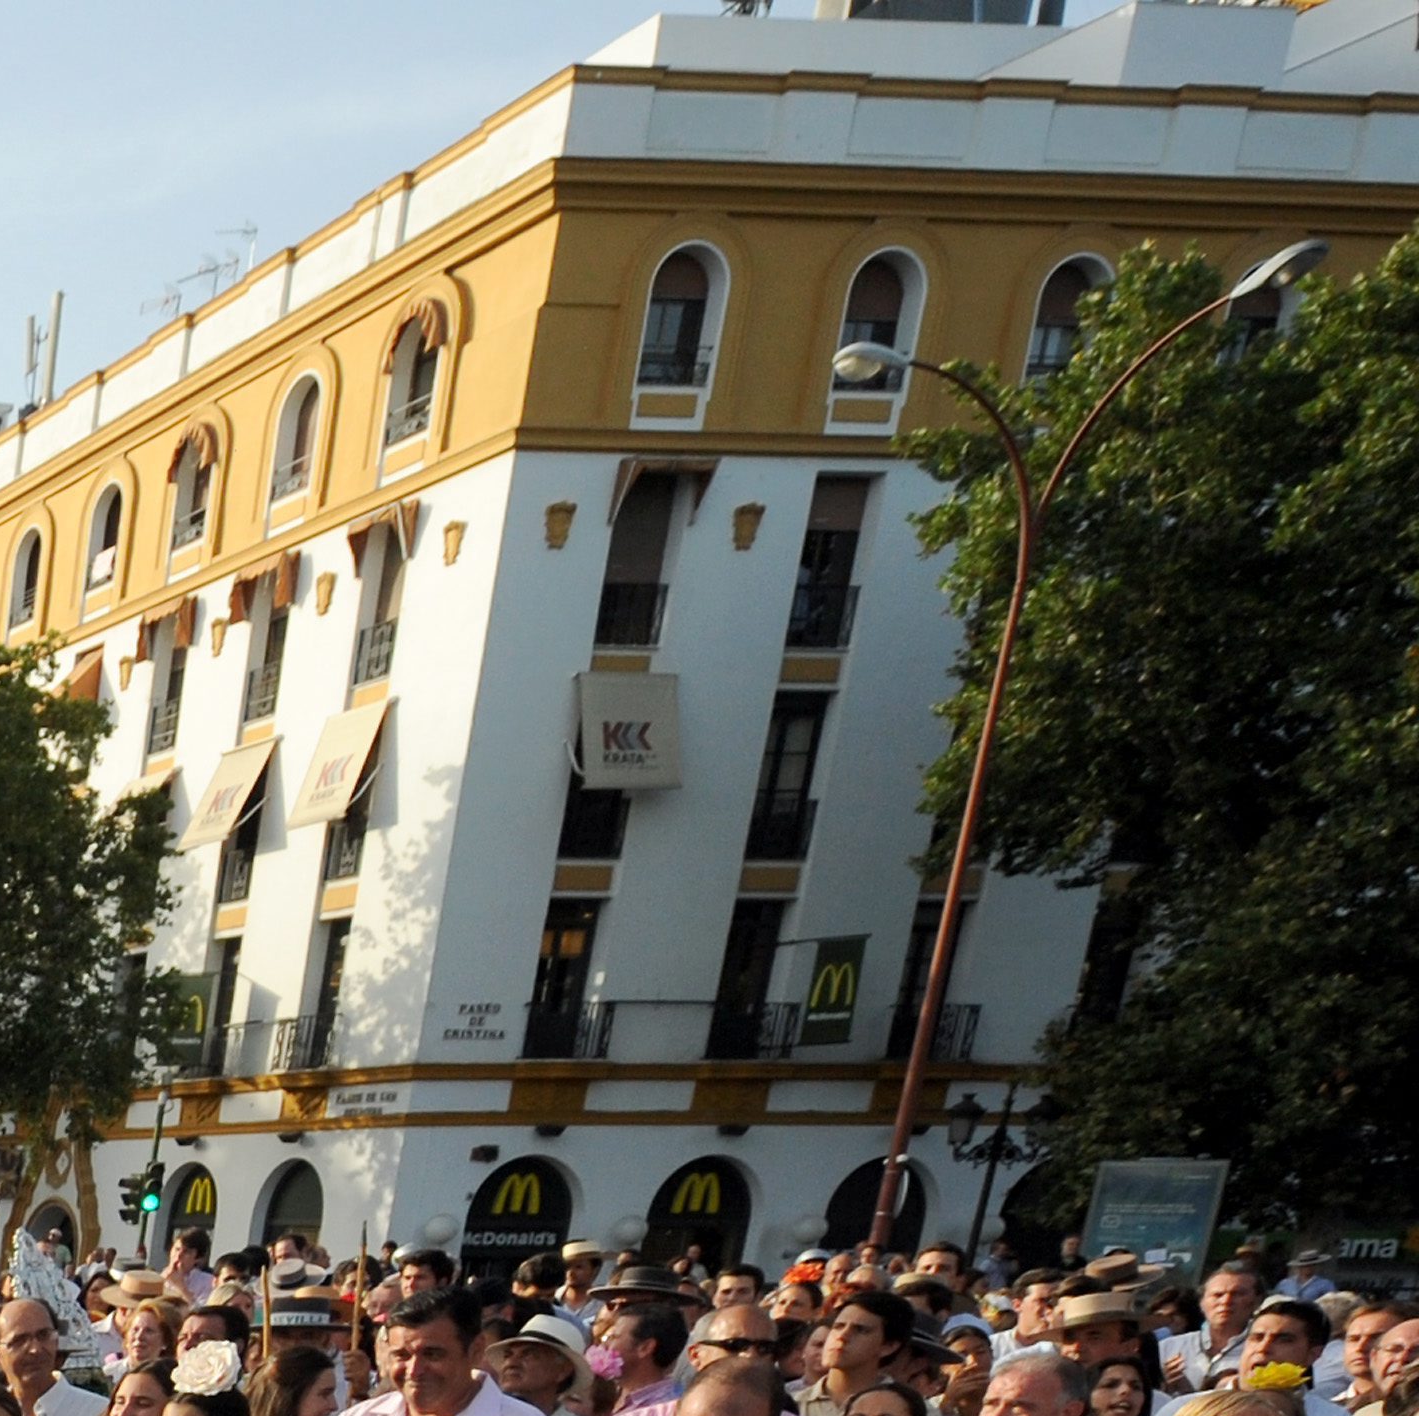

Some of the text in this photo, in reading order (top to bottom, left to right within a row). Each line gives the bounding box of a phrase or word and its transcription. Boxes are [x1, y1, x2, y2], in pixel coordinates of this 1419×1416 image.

[459, 1003, 501, 1015] PASEO
[469, 1016, 485, 1027] DE
[443, 1028, 506, 1040] CRISTINA
[463, 1231, 557, 1246] McDonald's
